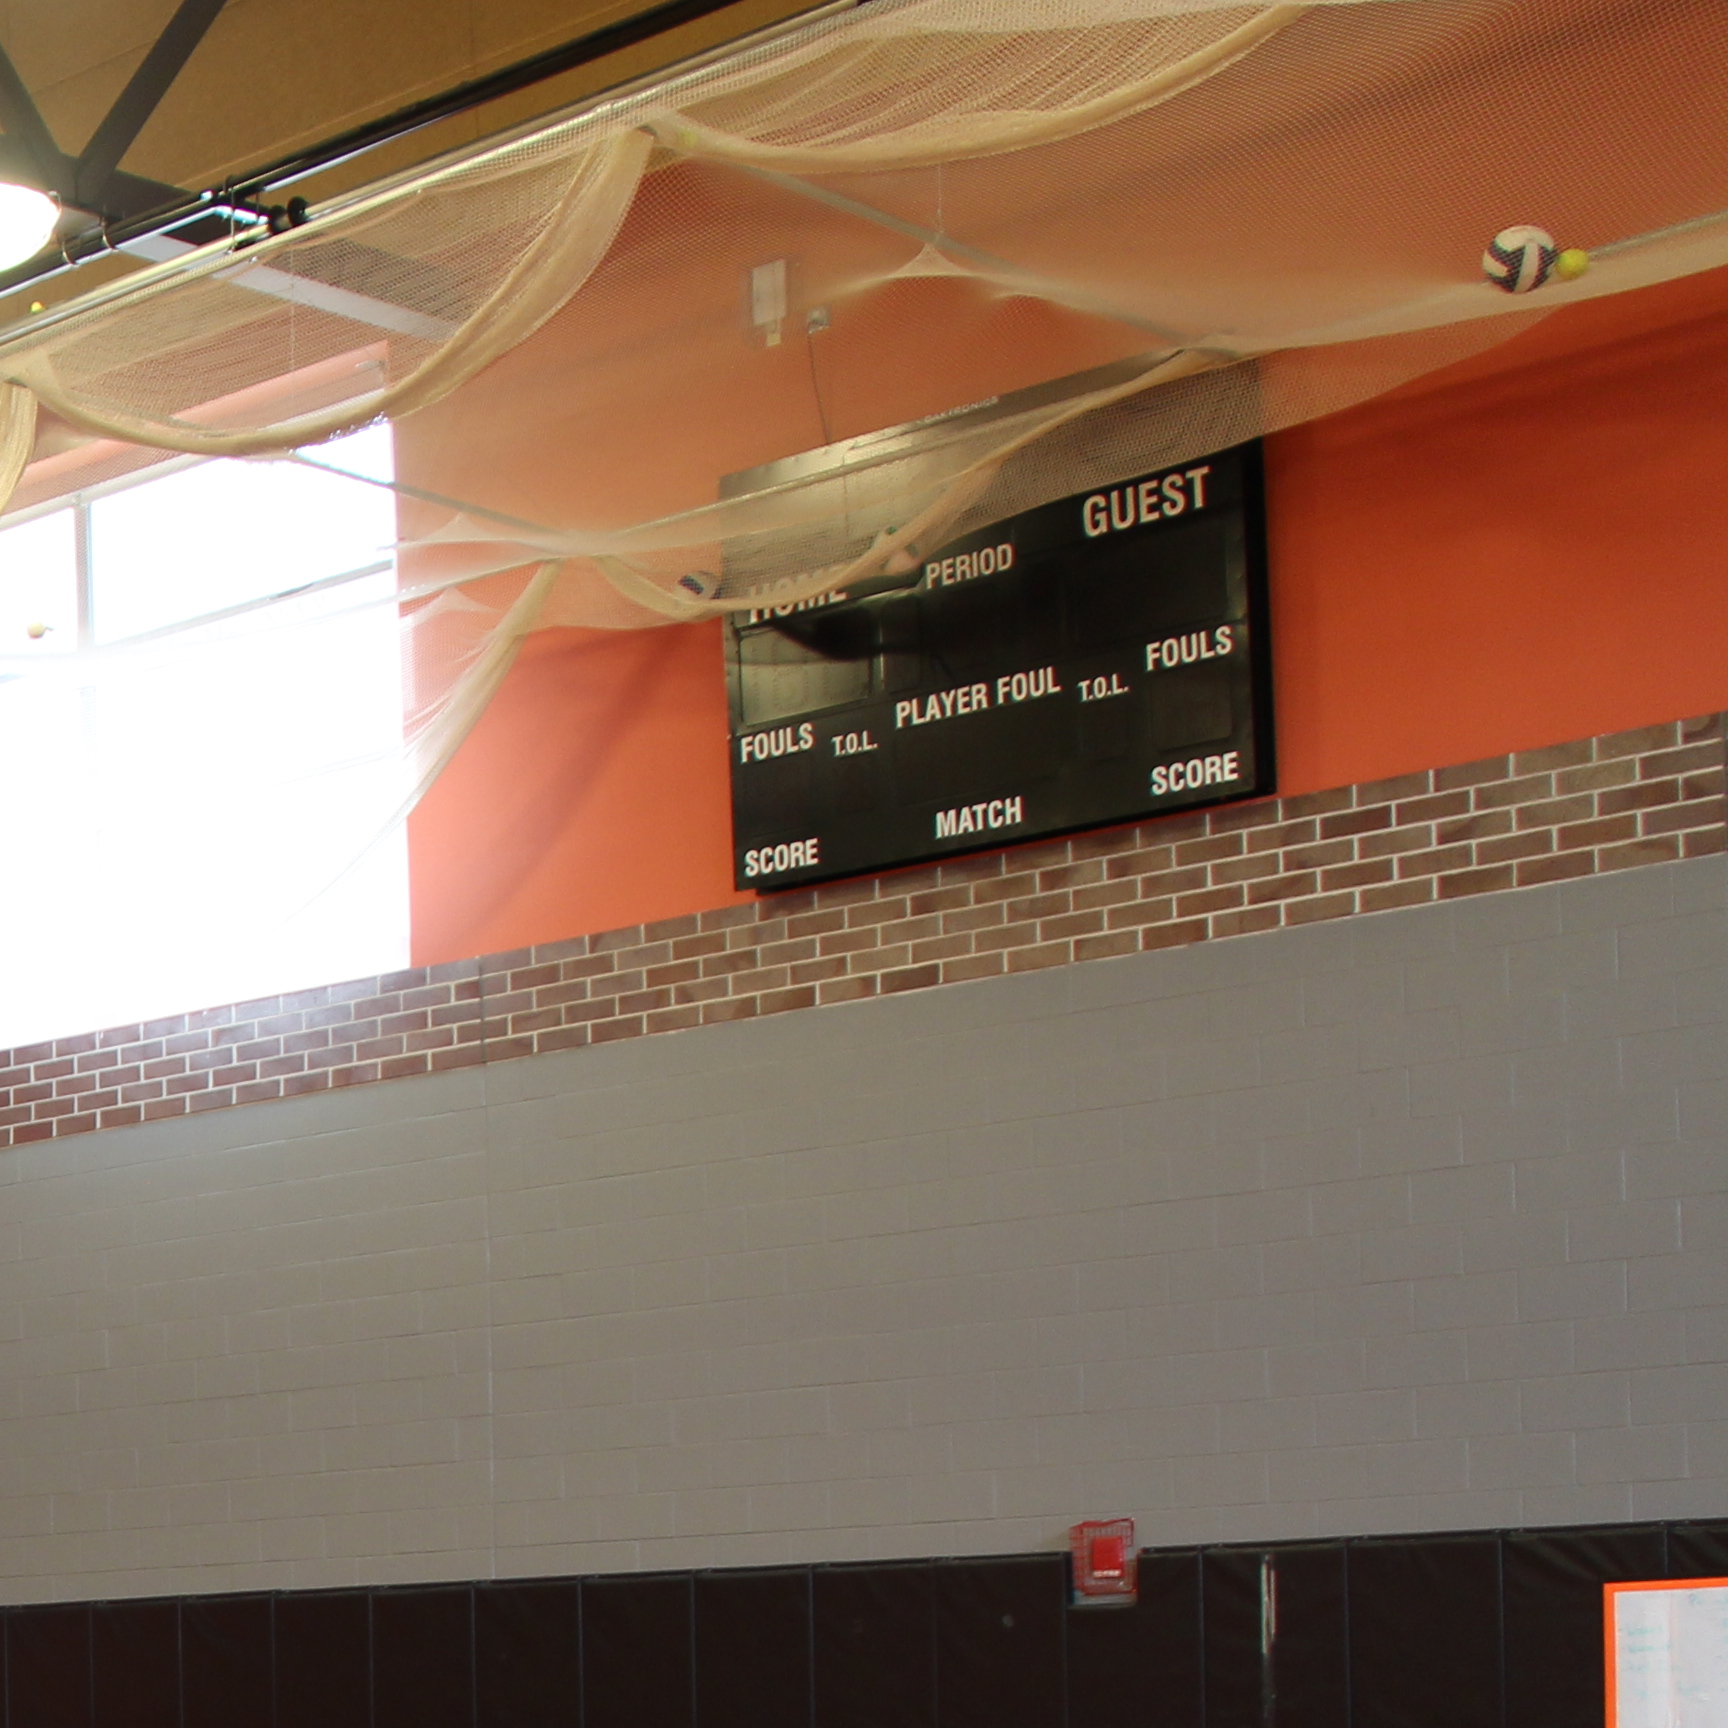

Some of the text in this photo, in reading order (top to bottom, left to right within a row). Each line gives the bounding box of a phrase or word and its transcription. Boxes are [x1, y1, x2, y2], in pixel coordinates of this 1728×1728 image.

[1083, 465, 1212, 537] GUEST
[926, 543, 1015, 589] PERIOD
[1145, 625, 1234, 671] FOULS
[895, 666, 1062, 728] PLAYER FOUL
[1078, 674, 1129, 702] T.O.L.
[740, 722, 814, 763] FOULS
[831, 730, 878, 757] T.O.L.
[1151, 751, 1240, 796] SCORE
[935, 796, 1022, 839] MATCH
[745, 838, 818, 877] SCORE
